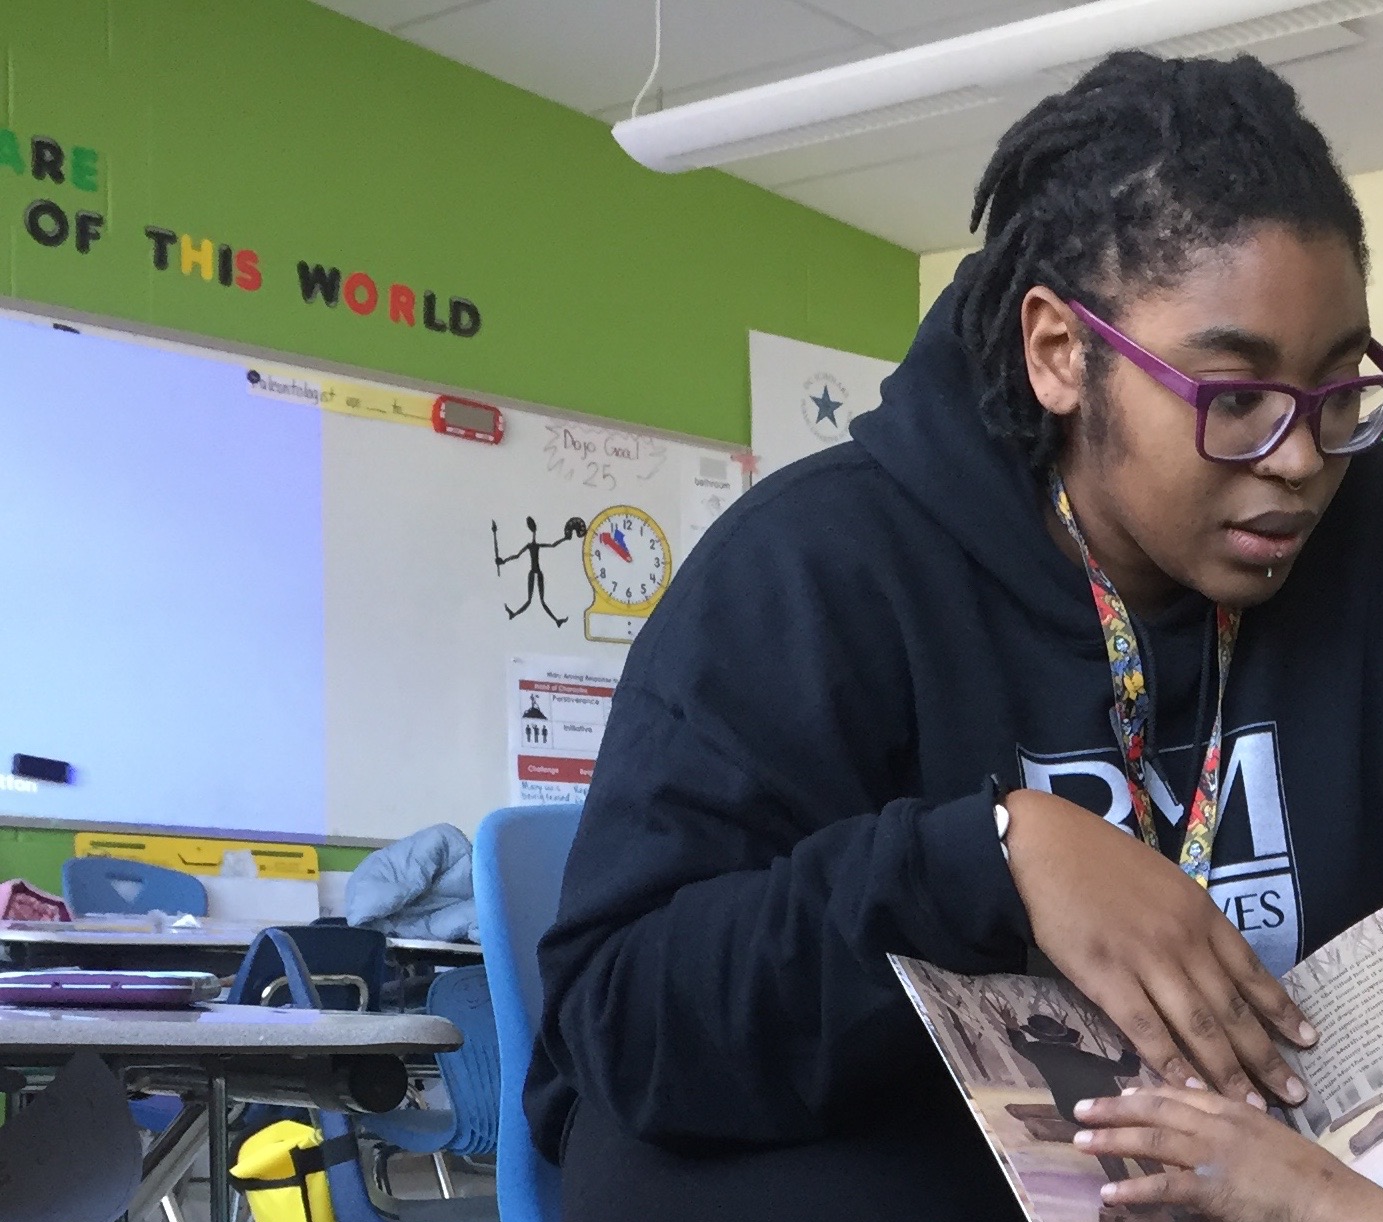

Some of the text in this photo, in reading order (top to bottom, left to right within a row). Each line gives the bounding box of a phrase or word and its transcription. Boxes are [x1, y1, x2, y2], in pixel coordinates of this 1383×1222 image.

[0, 129, 99, 192] ARE
[24, 199, 481, 337] OF THIS WORLD
[583, 462, 616, 490] 25
[623, 520, 633, 530] 12
[650, 539, 655, 550] 2
[594, 550, 602, 561] 9
[654, 557, 660, 568] 3
[600, 567, 606, 579] 8
[650, 573, 656, 584] 4
[612, 581, 618, 592] 7
[641, 583, 647, 594] 5
[626, 587, 632, 598] 6
[528, 764, 559, 775] Challenge
